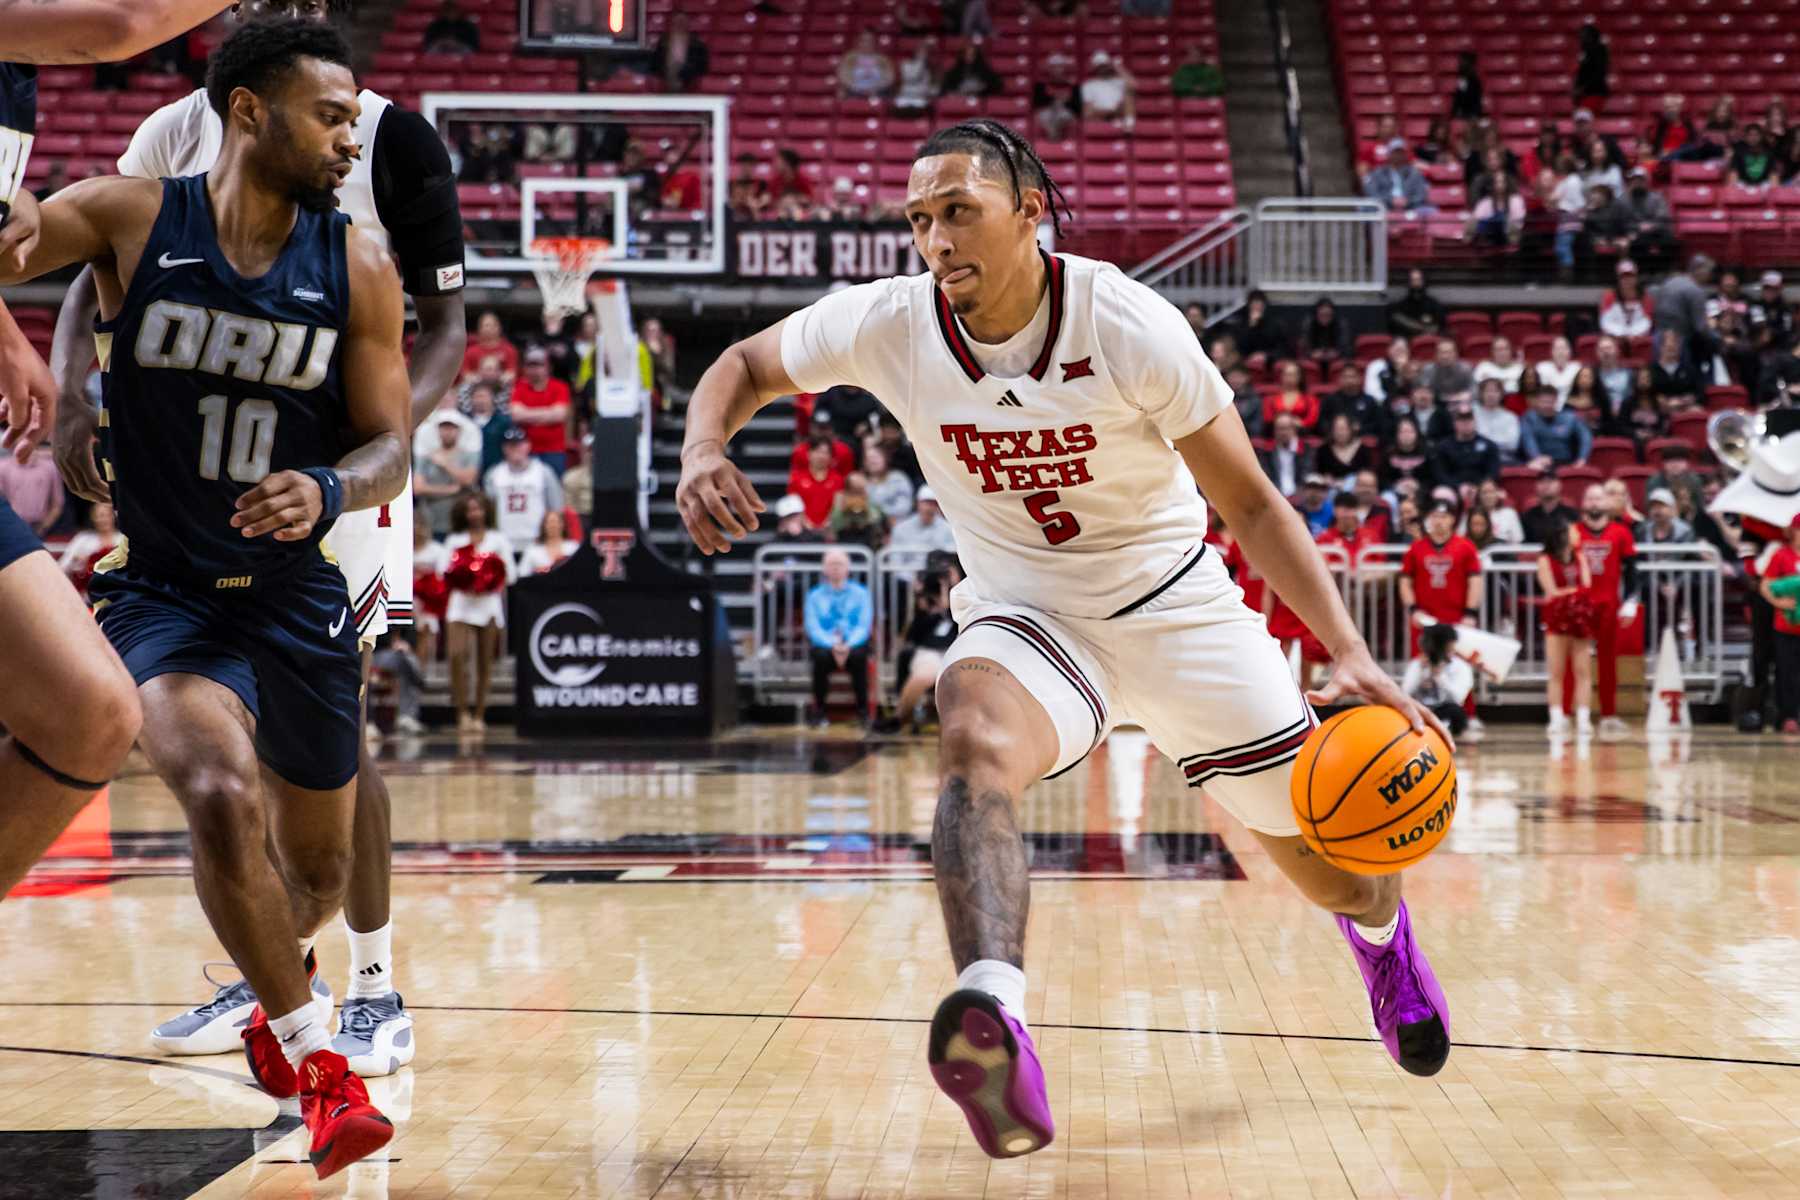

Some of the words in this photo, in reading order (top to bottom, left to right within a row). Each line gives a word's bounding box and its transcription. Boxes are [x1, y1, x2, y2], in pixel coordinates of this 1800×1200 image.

[135, 299, 338, 390] ORU
[198, 394, 278, 483] 10
[940, 423, 1097, 461] TEXAS
[964, 457, 1094, 493] TECH
[1023, 490, 1081, 546] 5
[215, 576, 252, 589] ORU
[540, 634, 700, 657] CAREnomics
[533, 683, 698, 707] WOUNDCARE
[1377, 745, 1438, 805] NCAA
